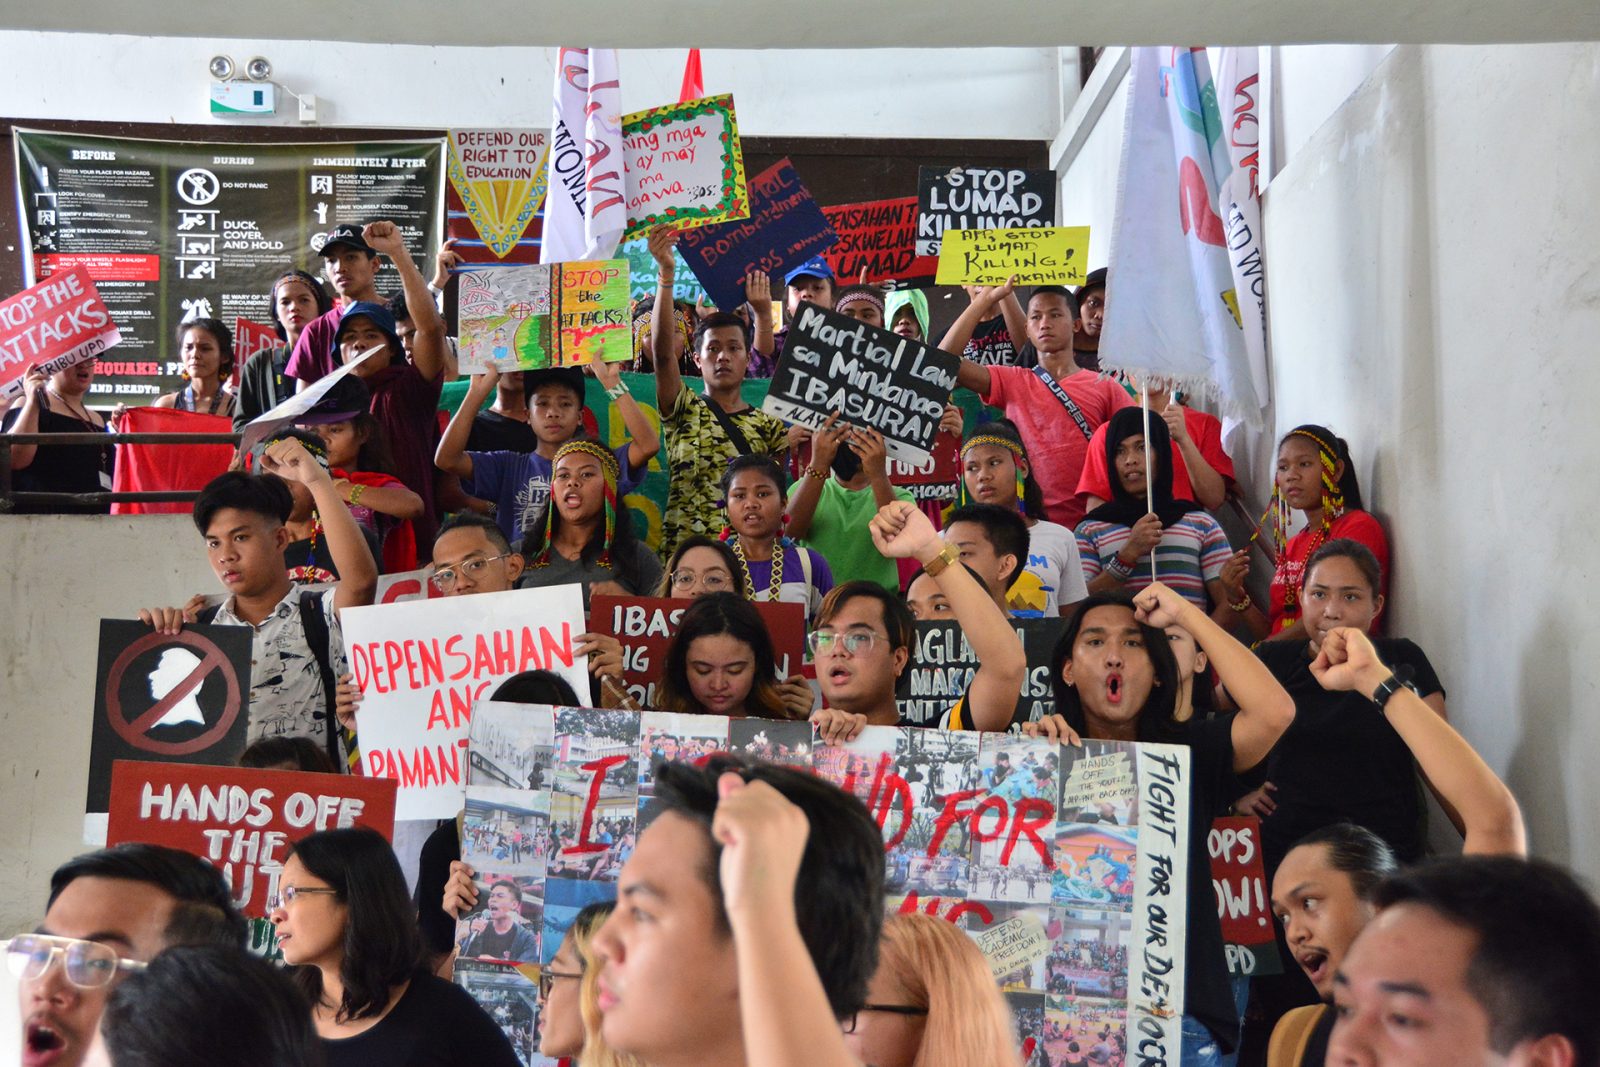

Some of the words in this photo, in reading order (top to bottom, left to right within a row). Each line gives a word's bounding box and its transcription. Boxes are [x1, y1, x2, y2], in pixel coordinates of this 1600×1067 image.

[457, 132, 513, 146] DEFEND
[519, 133, 545, 146] OUR
[666, 125, 706, 147] mga
[72, 149, 116, 160] BEFORE
[213, 156, 255, 165] DURING
[313, 157, 388, 167] IMMEDIATELY
[391, 158, 427, 168] AFTER
[463, 148, 508, 162] RIGHT
[513, 149, 537, 164] TO
[662, 145, 697, 164] may
[466, 165, 532, 179] EDUCATION
[945, 166, 1026, 194] STOP
[930, 186, 1043, 216] LUMAD
[222, 241, 249, 249] AND
[251, 241, 284, 250] HOLD
[974, 241, 1039, 256] LUMAD
[1004, 230, 1056, 239] STOP
[563, 267, 620, 288] STOP
[837, 249, 917, 278] UMAD
[0, 295, 38, 331] TOP
[37, 273, 85, 309] THE
[575, 289, 604, 303] the
[0, 299, 108, 371] ATTACKS
[79, 338, 106, 358] UPD
[798, 306, 907, 372] Martial
[909, 346, 957, 391] Law
[89, 384, 113, 394] AND
[791, 345, 822, 368] sa
[828, 350, 945, 420] Mindanao
[782, 367, 934, 448] IBASURA!
[1040, 372, 1094, 440] SUPREM
[352, 621, 574, 695] DEPENSAHAN
[1080, 755, 1116, 770] HANDS
[1081, 768, 1105, 780] OFF
[140, 781, 274, 827] HANDS
[284, 791, 366, 832] OFF
[1141, 750, 1181, 849] FIGHT
[927, 787, 1058, 871] FOR
[203, 828, 288, 868] THE
[1207, 827, 1255, 865] OPS
[1145, 852, 1174, 897] FOR
[976, 918, 1023, 946] DEFEND
[1145, 904, 1169, 949] OUR
[1224, 943, 1256, 975] PD
